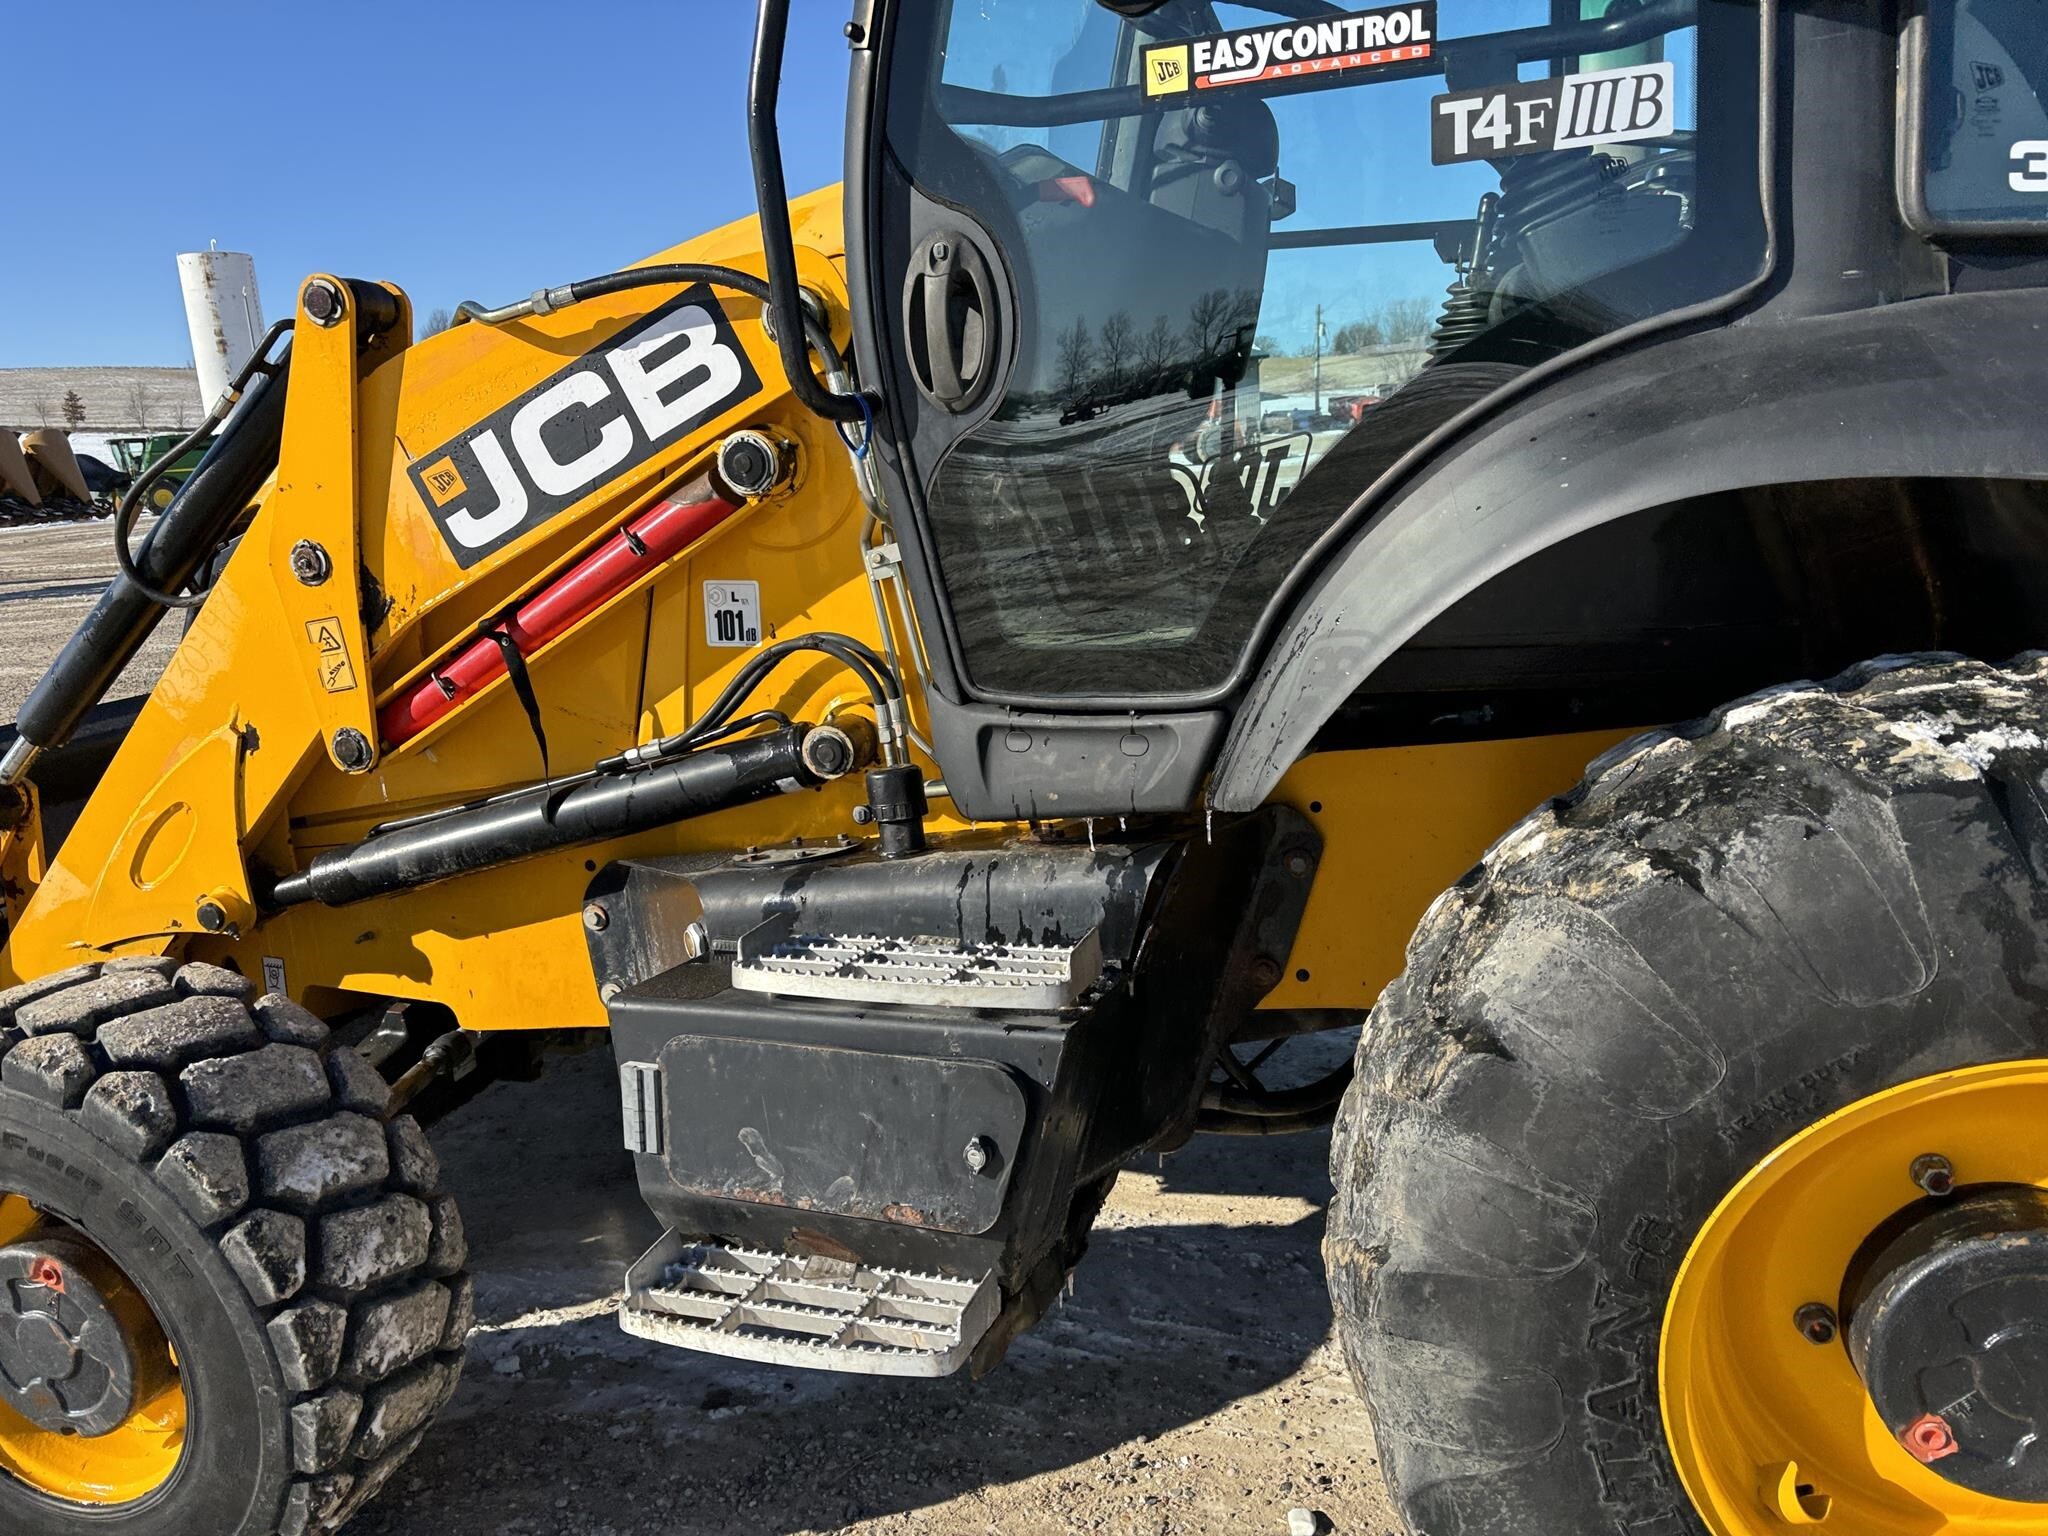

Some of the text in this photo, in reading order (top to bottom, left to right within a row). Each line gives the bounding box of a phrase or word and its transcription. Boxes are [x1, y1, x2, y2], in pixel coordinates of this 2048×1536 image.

[1157, 60, 1180, 81] JCB
[1272, 47, 1423, 76] ADVANCED
[1440, 94, 1553, 155] T4F
[445, 304, 743, 548] JCB
[434, 471, 456, 491] JCB
[714, 609, 757, 642] 101 dB
